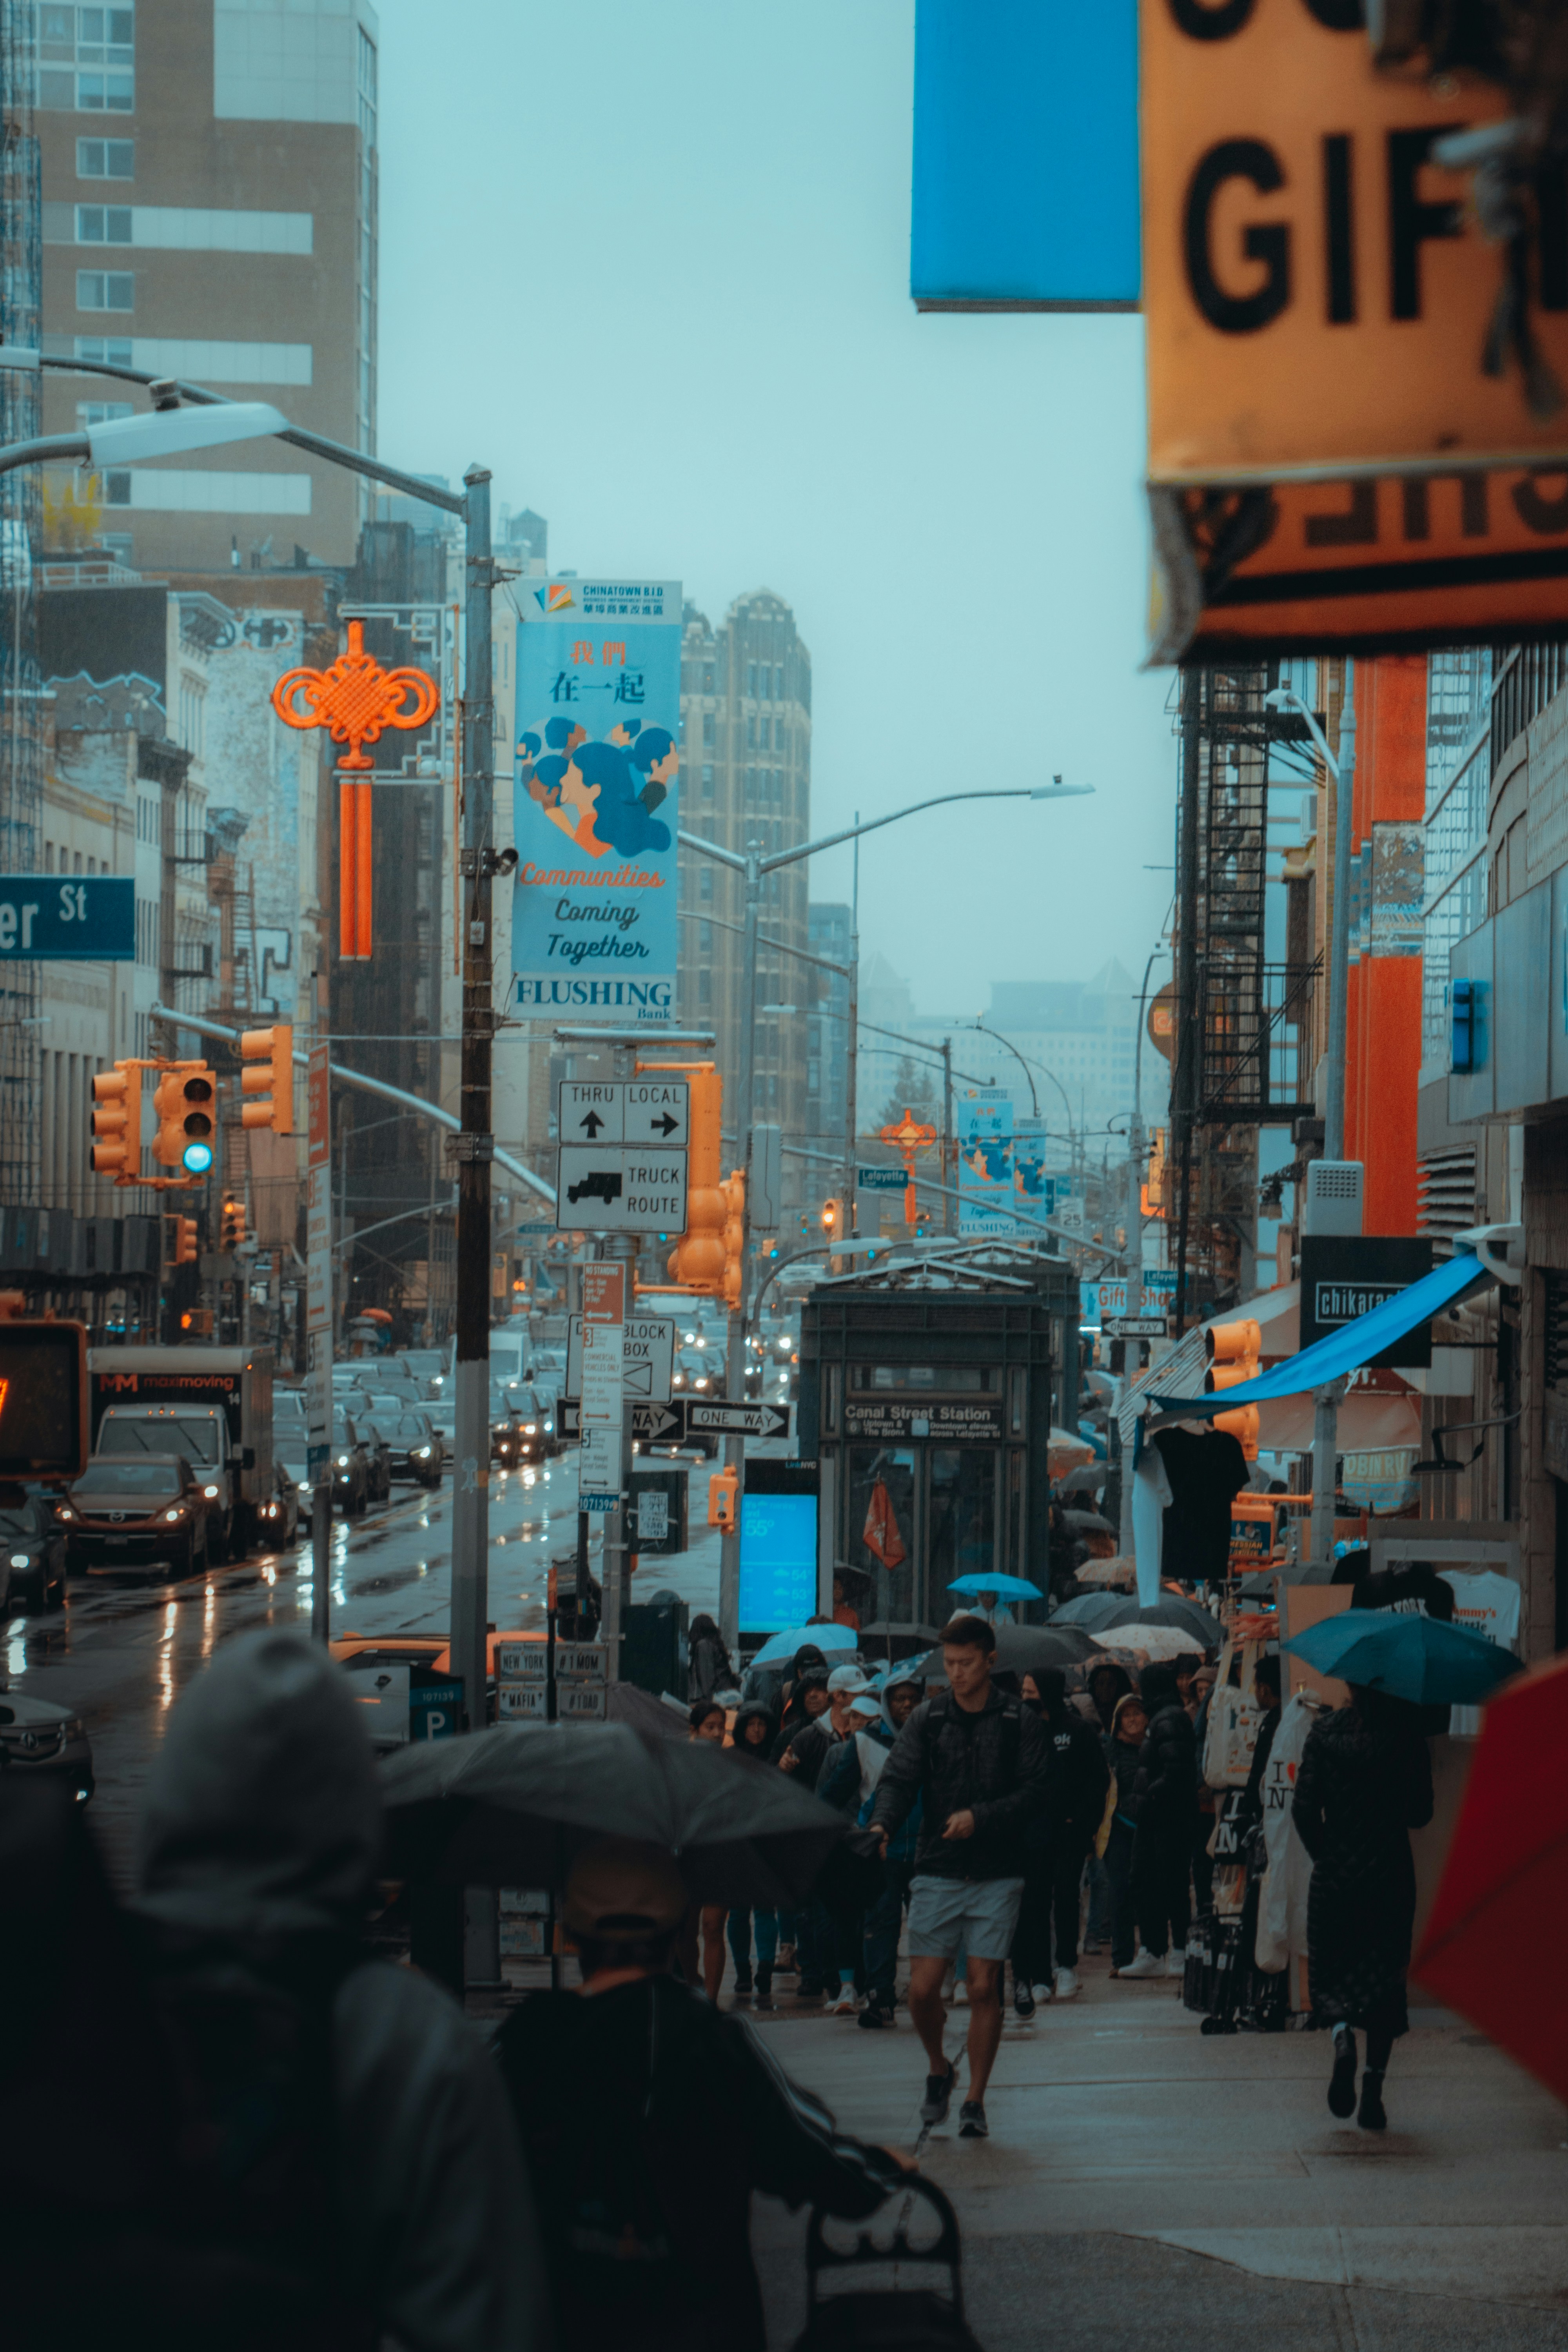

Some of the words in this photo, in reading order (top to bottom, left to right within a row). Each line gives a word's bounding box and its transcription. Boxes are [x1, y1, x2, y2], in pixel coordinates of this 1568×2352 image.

[583, 585, 641, 597] CHINATOWN
[570, 640, 626, 666] 我們
[550, 671, 645, 704] 在一起
[520, 862, 666, 888] Communities
[59, 884, 87, 921] St
[555, 898, 640, 931] Coming
[547, 934, 650, 965] Together
[515, 980, 672, 1007] FLUSHING
[637, 1007, 671, 1020] Bank
[572, 1087, 614, 1102] THRU
[629, 1087, 681, 1103] LOCAL
[629, 1167, 680, 1184] TRUCK
[628, 1197, 679, 1213] ROUTE
[961, 1222, 1014, 1233] FLUSHING
[1063, 1214, 1081, 1226] 25
[586, 1266, 593, 1275] NO
[594, 1266, 618, 1276] STANDING
[1099, 1285, 1125, 1307] Gift
[1111, 1322, 1128, 1332] ONE
[1139, 1322, 1159, 1332] WAY
[585, 1328, 592, 1346] 3
[624, 1342, 650, 1357] BOX
[584, 1353, 617, 1362] COMMERCIAL
[584, 1363, 606, 1372] VEHICLES
[607, 1364, 620, 1372] ONLY
[144, 1374, 234, 1391] maximoving
[596, 1396, 610, 1405] Sunday
[701, 1411, 730, 1425] ONE
[745, 1413, 776, 1428] WAY
[845, 1404, 886, 1419] Canal
[891, 1406, 934, 1420] Street
[940, 1406, 991, 1421] Station
[632, 1413, 665, 1428] WAY
[863, 1419, 894, 1429] Uptown
[896, 1419, 903, 1428] &
[929, 1422, 967, 1430] Downtown
[969, 1422, 998, 1431] elevator
[583, 1428, 590, 1447] 5
[863, 1428, 879, 1436] The
[882, 1428, 906, 1437] Bronx
[956, 1430, 990, 1440] Lafayette
[785, 1461, 817, 1470] LinkNYC
[503, 1655, 520, 1669] NEW
[524, 1655, 544, 1669] YORK
[577, 1655, 599, 1670] MOM
[422, 1690, 454, 1702] 107139
[427, 1711, 446, 1741] P
[1272, 1760, 1285, 1784] I
